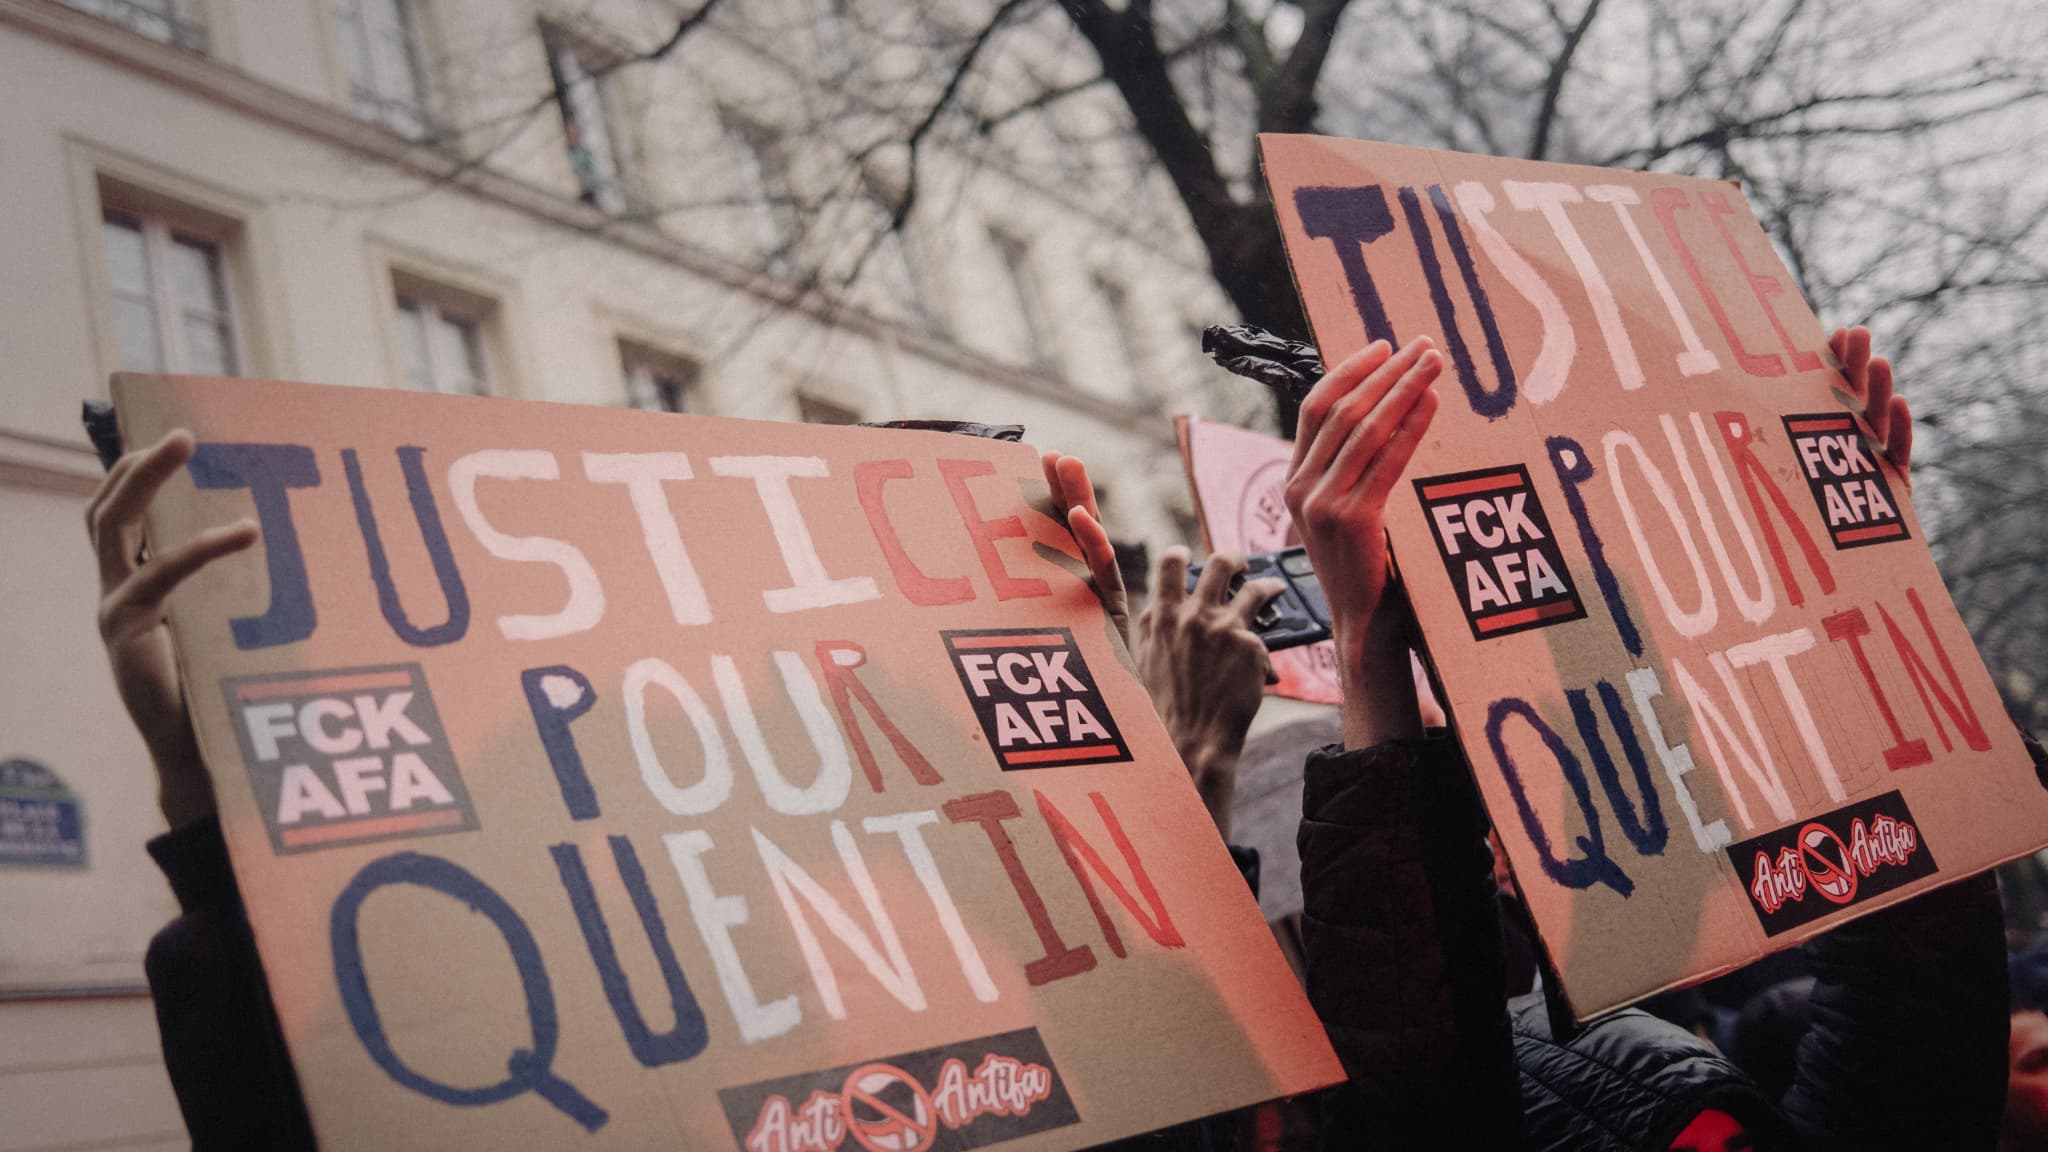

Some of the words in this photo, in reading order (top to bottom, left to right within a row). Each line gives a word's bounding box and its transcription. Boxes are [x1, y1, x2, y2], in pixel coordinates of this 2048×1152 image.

[1293, 179, 1825, 422] JUSTICE
[1795, 433, 1876, 479] FCK
[1430, 492, 1545, 556] FCK
[1546, 409, 1836, 658] POUR
[1824, 480, 1897, 528] AFA
[187, 443, 1053, 651] JUSTICE
[1463, 549, 1567, 613] AFA
[959, 650, 1087, 698] FCK
[242, 690, 431, 762] FCK
[521, 640, 945, 821] POUR
[995, 698, 1111, 747] AFA
[1486, 587, 1993, 900] QUENTIN
[276, 752, 454, 825] AFA
[1753, 850, 1805, 911] Anti
[1851, 816, 1915, 875] Antifa
[330, 790, 1186, 1132] QUENTIN
[749, 1095, 844, 1152] Anti
[934, 1056, 1048, 1126] Antifa
